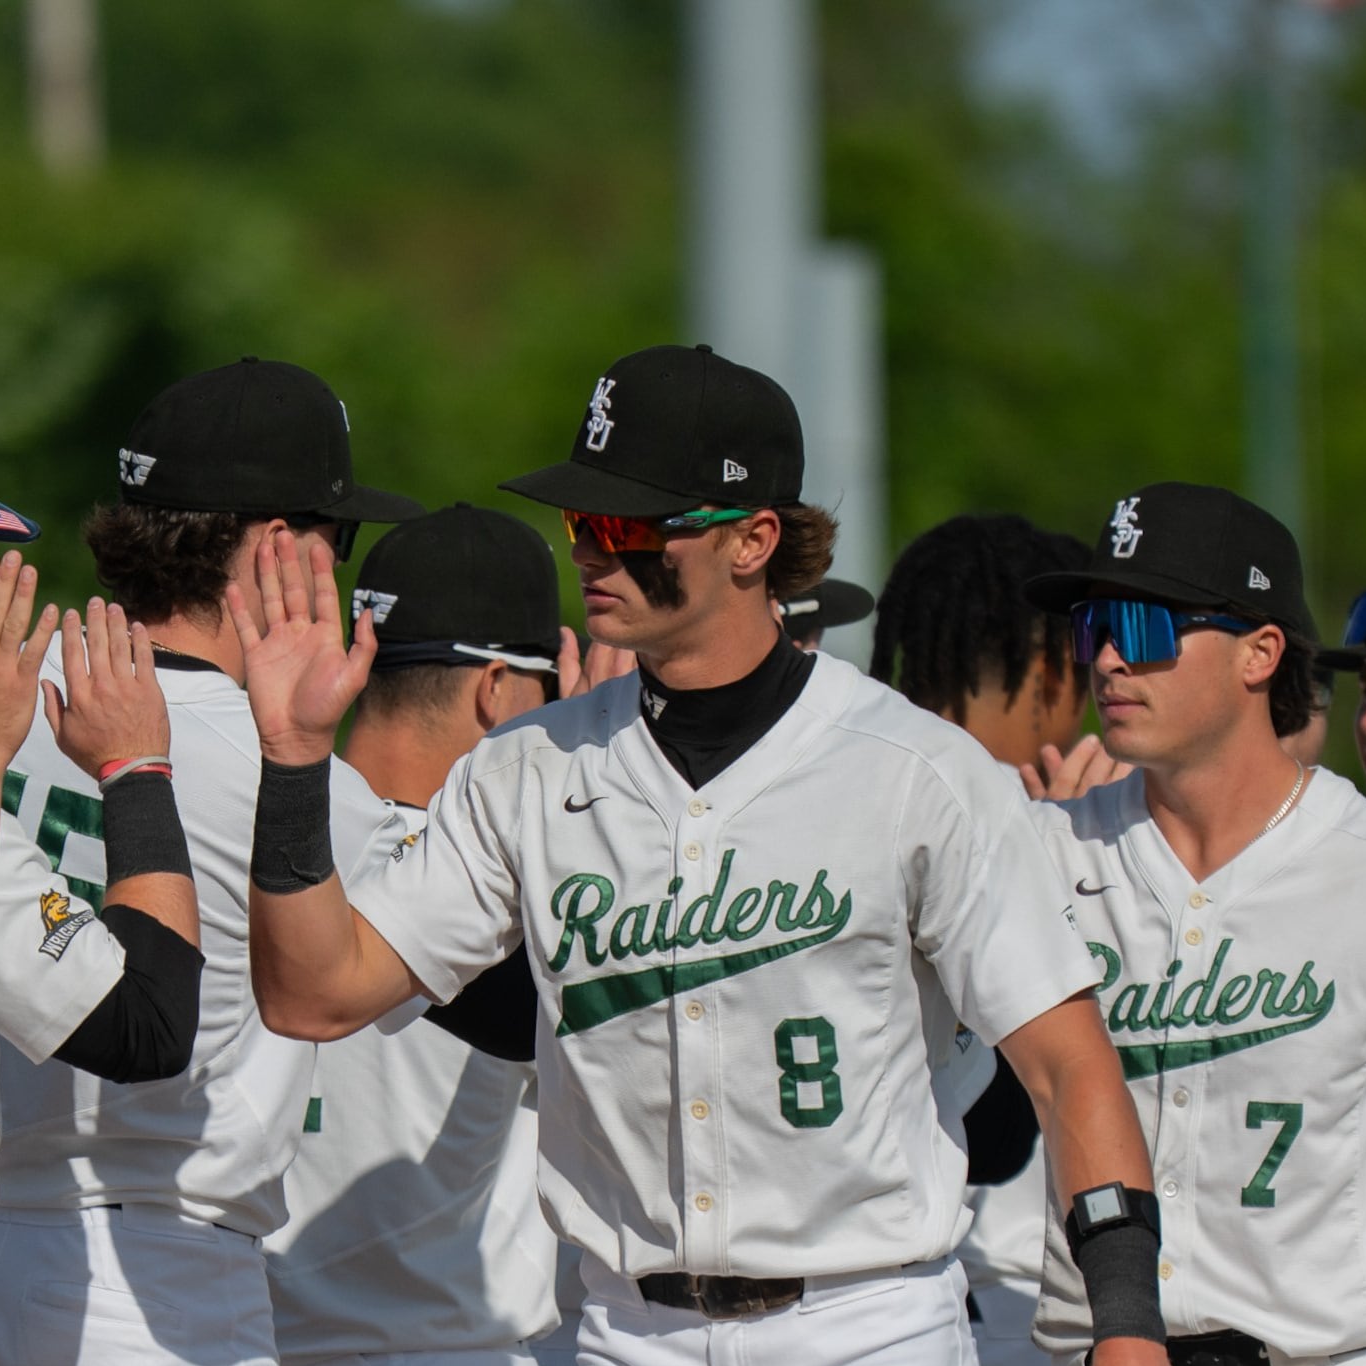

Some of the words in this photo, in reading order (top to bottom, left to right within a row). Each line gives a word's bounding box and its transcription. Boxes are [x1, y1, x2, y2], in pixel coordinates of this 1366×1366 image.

[548, 848, 852, 973] Raiders
[774, 1016, 844, 1128] 8
[1241, 1101, 1304, 1208] 7
